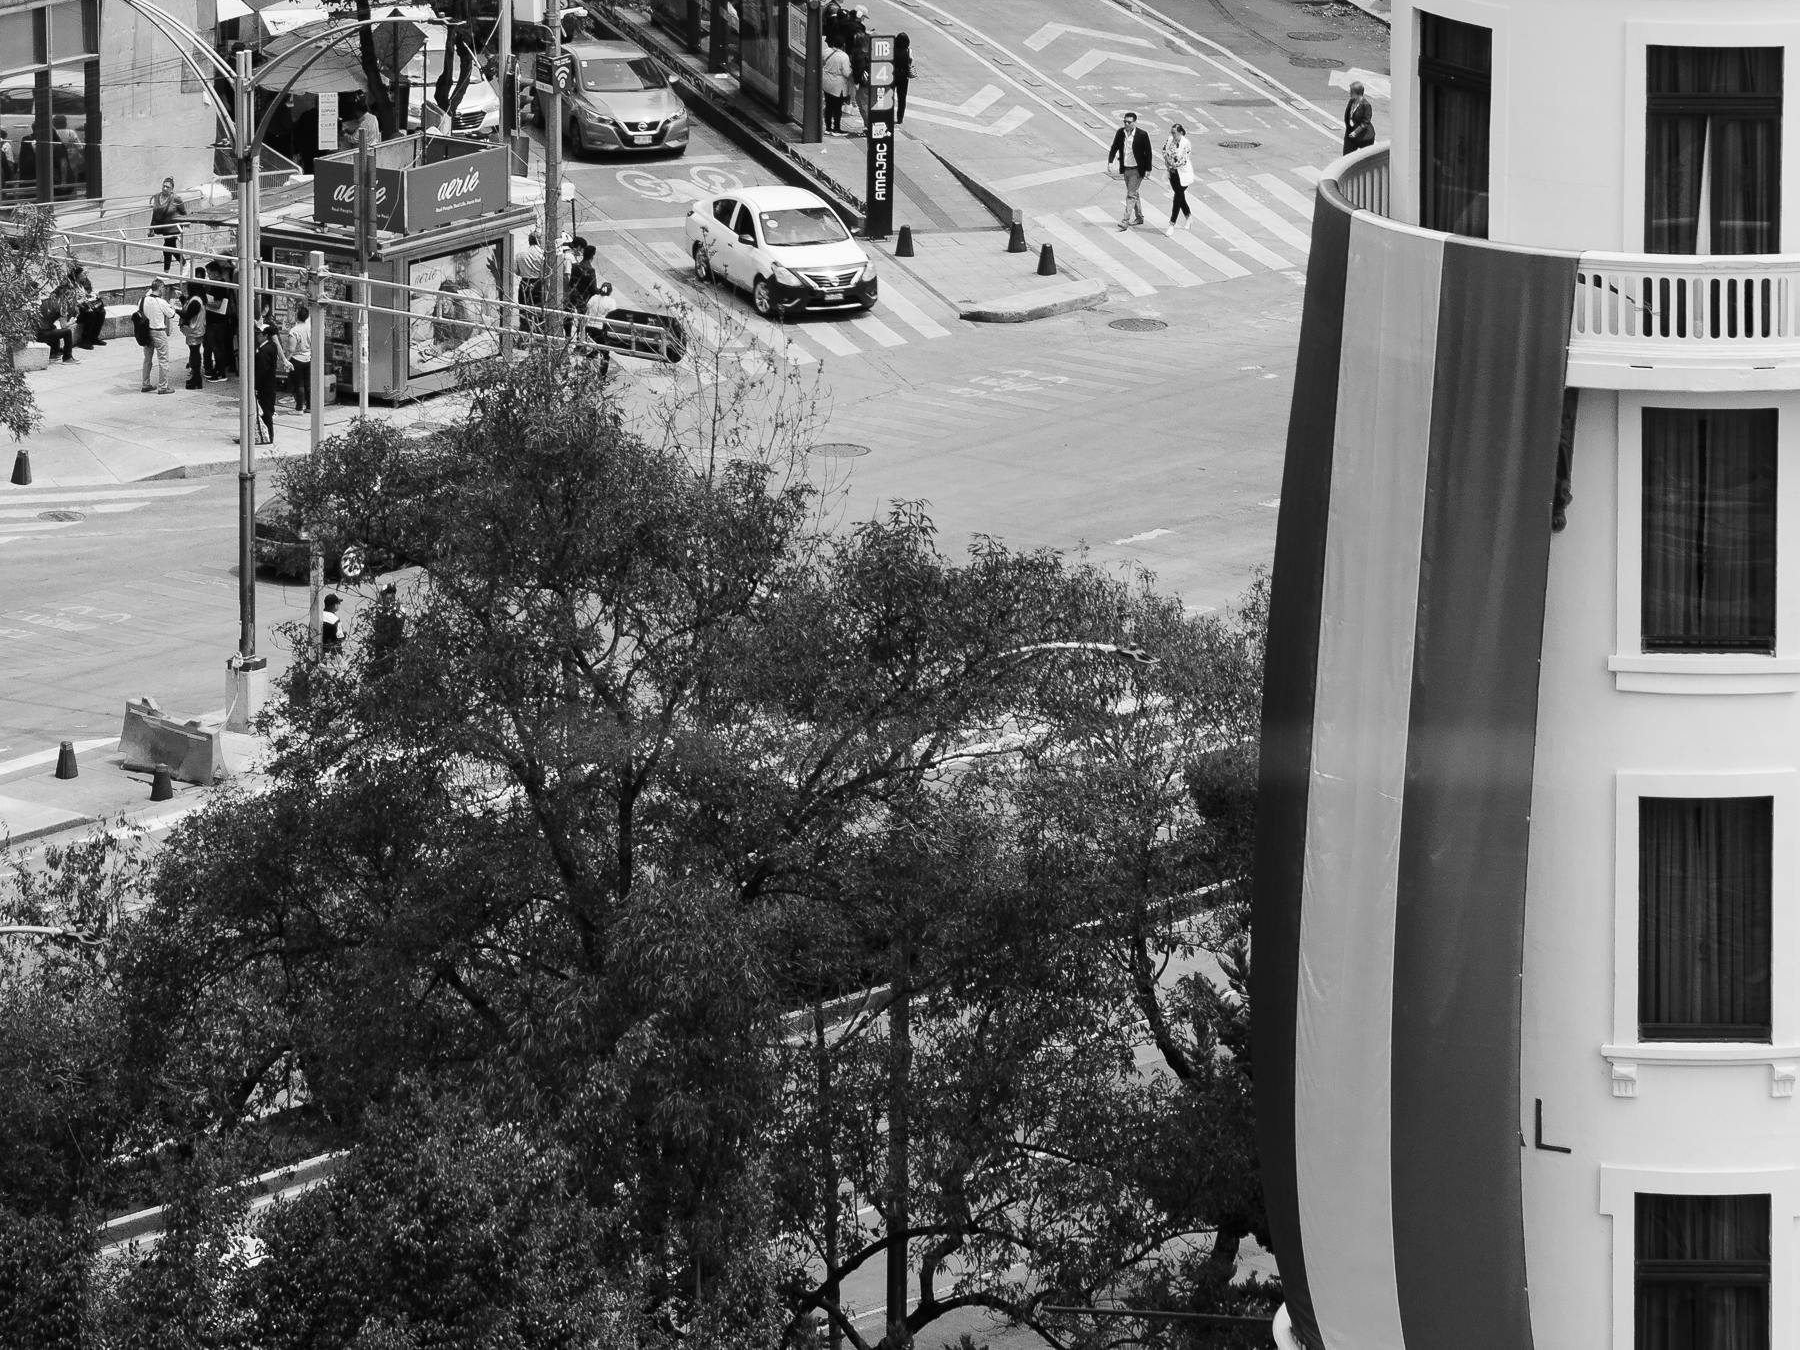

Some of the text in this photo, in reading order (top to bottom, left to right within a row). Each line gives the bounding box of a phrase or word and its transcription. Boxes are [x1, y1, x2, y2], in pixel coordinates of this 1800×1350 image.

[875, 41, 890, 56] MB
[876, 66, 889, 81] 4
[875, 143, 887, 201] AMAJAC
[334, 180, 387, 204] aee
[438, 166, 480, 202] aerie
[415, 268, 437, 285] aerie
